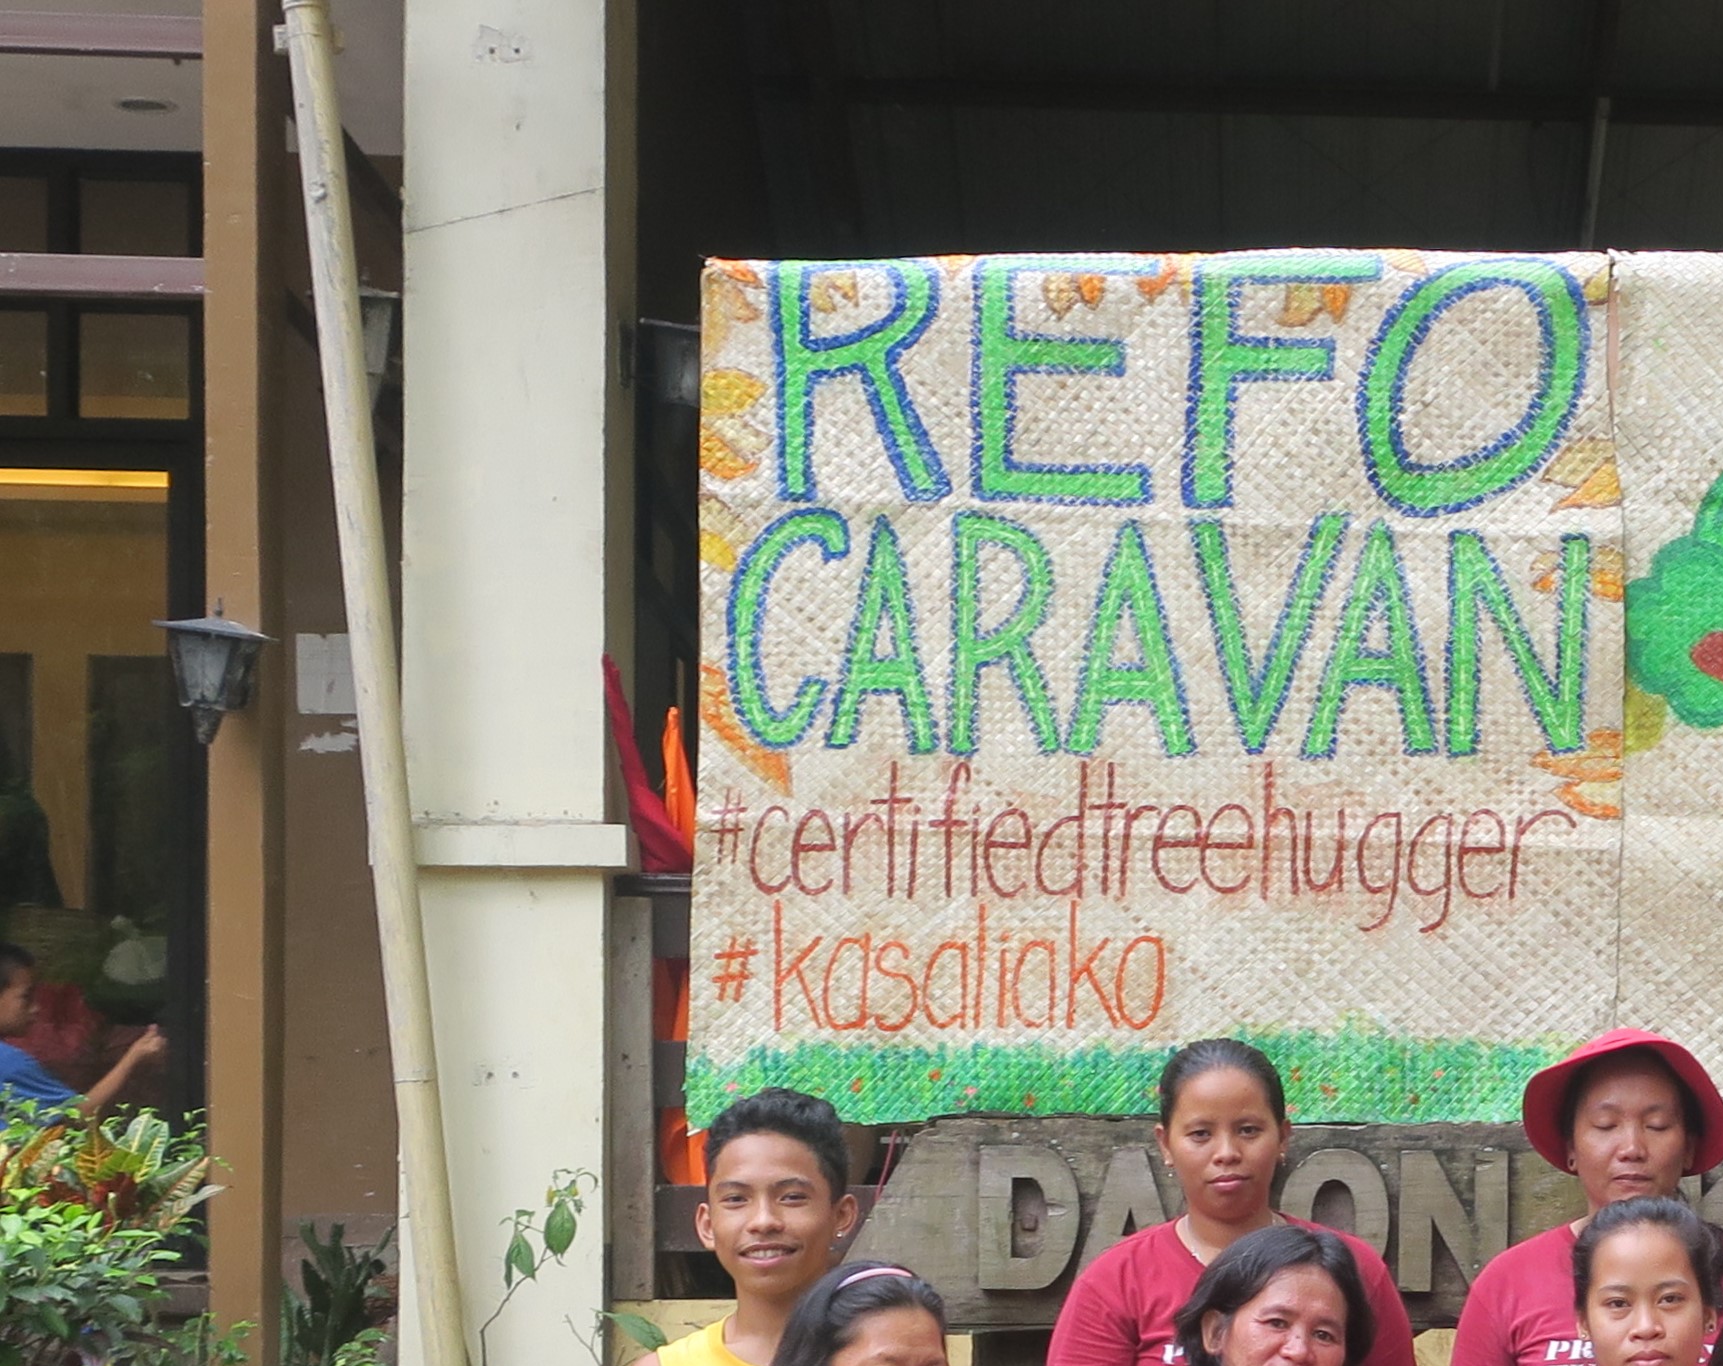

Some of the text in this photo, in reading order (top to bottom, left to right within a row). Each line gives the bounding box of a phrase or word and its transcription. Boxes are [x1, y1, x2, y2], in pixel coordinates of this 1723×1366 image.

[769, 257, 1591, 518] REFO
[726, 507, 1592, 760] CARAVAN
[710, 761, 1577, 932] #certifiedtreehugger
[712, 900, 1167, 1031] #kasaliako
[979, 1145, 1510, 1291] DAON
